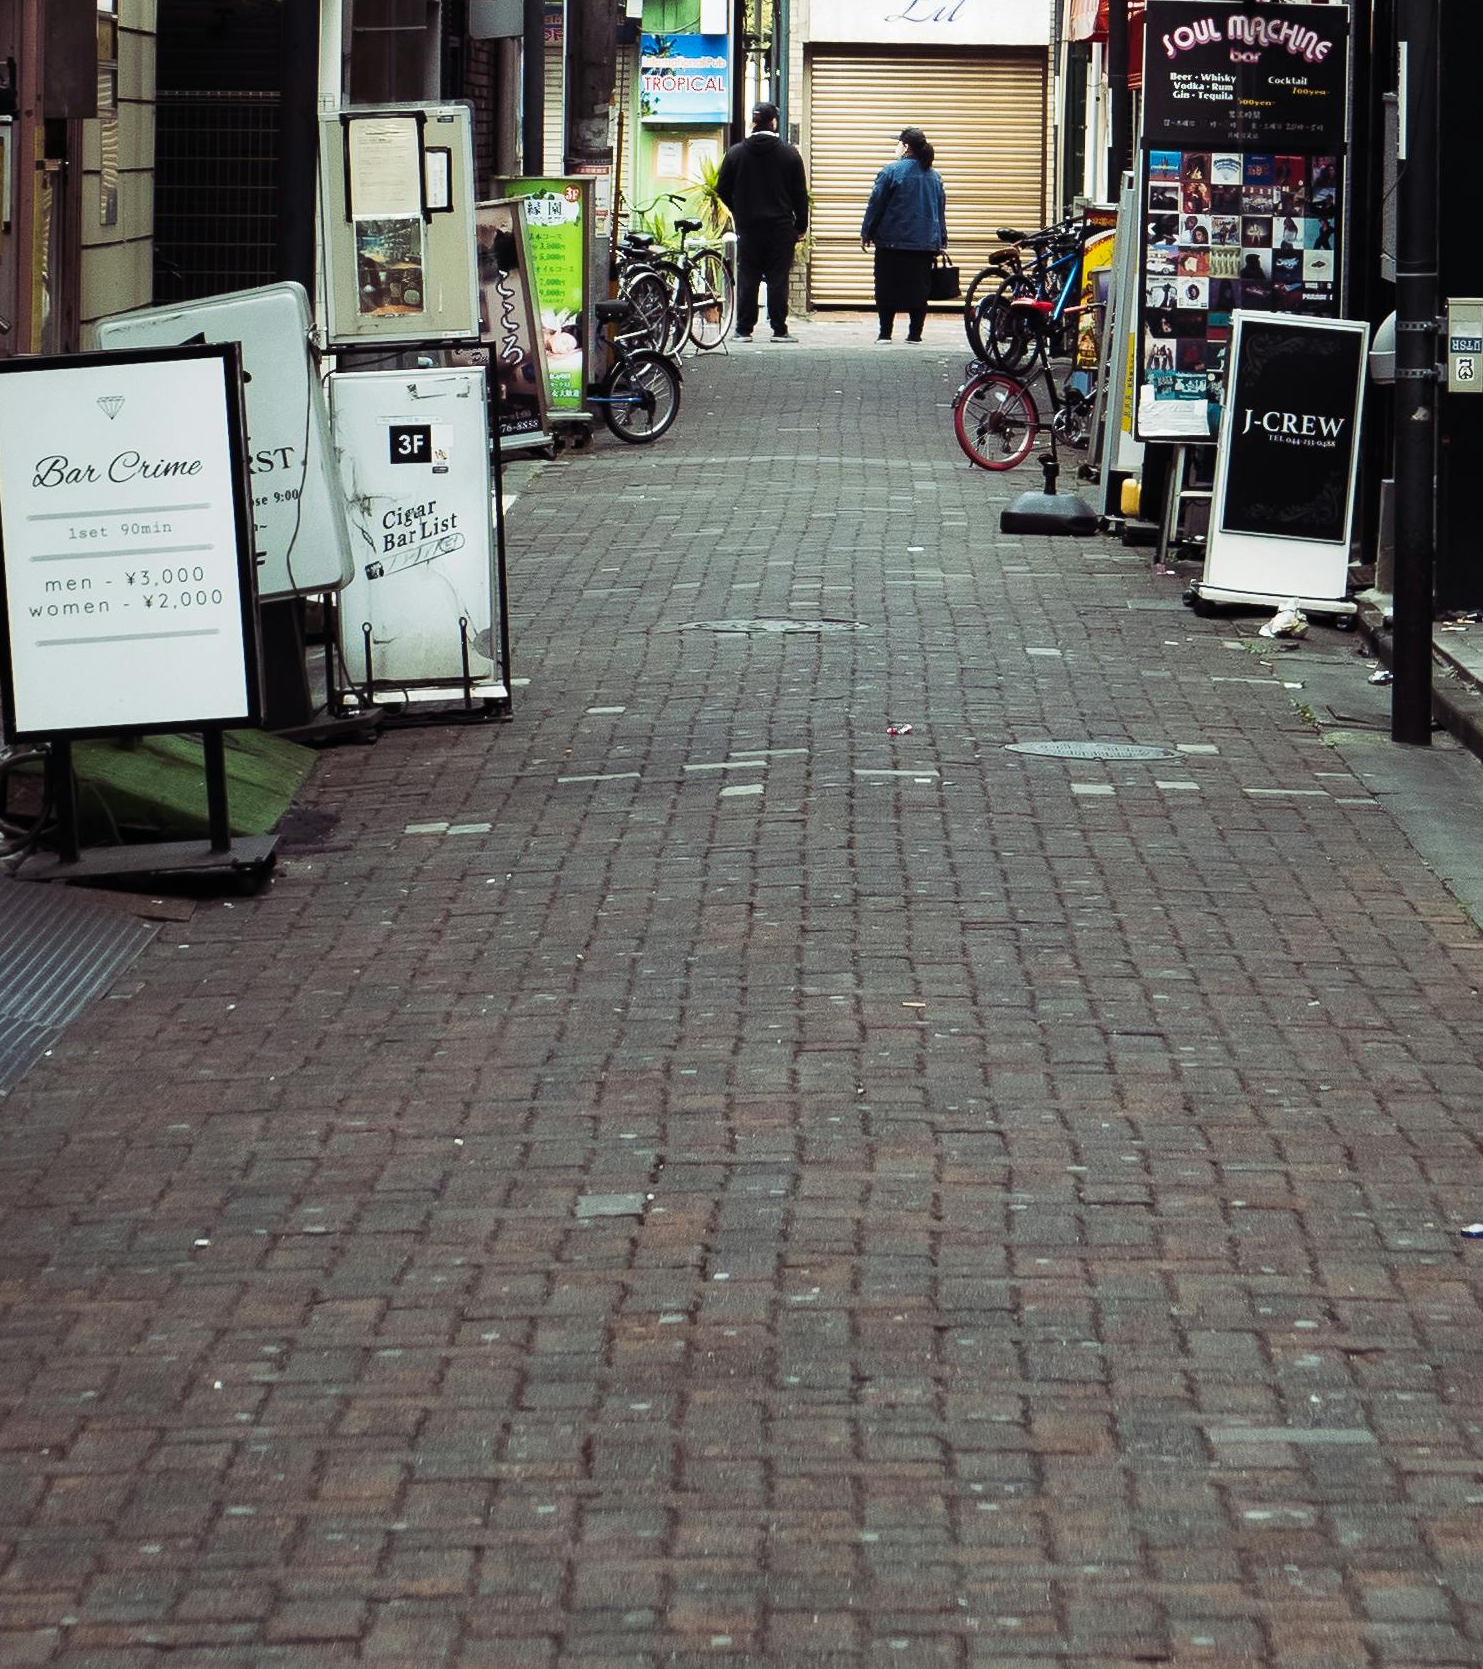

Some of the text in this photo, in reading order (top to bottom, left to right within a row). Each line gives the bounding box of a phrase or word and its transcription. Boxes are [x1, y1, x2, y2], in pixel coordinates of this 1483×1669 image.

[1161, 14, 1334, 64] SOUL MACHINE
[1229, 47, 1262, 64] bar
[643, 75, 725, 92] TROPICAL
[1169, 71, 1237, 85] Beer Whisky
[1173, 81, 1234, 92] Vodka Rum
[1268, 75, 1308, 86] Cocktail
[1198, 91, 1234, 102] Tequila
[1242, 408, 1346, 438] J-CREW
[398, 434, 424, 454] 3F
[32, 450, 203, 487] Bar Crime
[273, 488, 300, 503] 9:00
[382, 500, 437, 529] Cigar
[68, 521, 173, 540] 1set 90min
[382, 529, 417, 553] Bar
[419, 512, 458, 540] List
[45, 576, 93, 592] men
[124, 566, 205, 588] ¥3,000
[29, 599, 110, 618] women
[142, 589, 223, 611] ¥2,000
